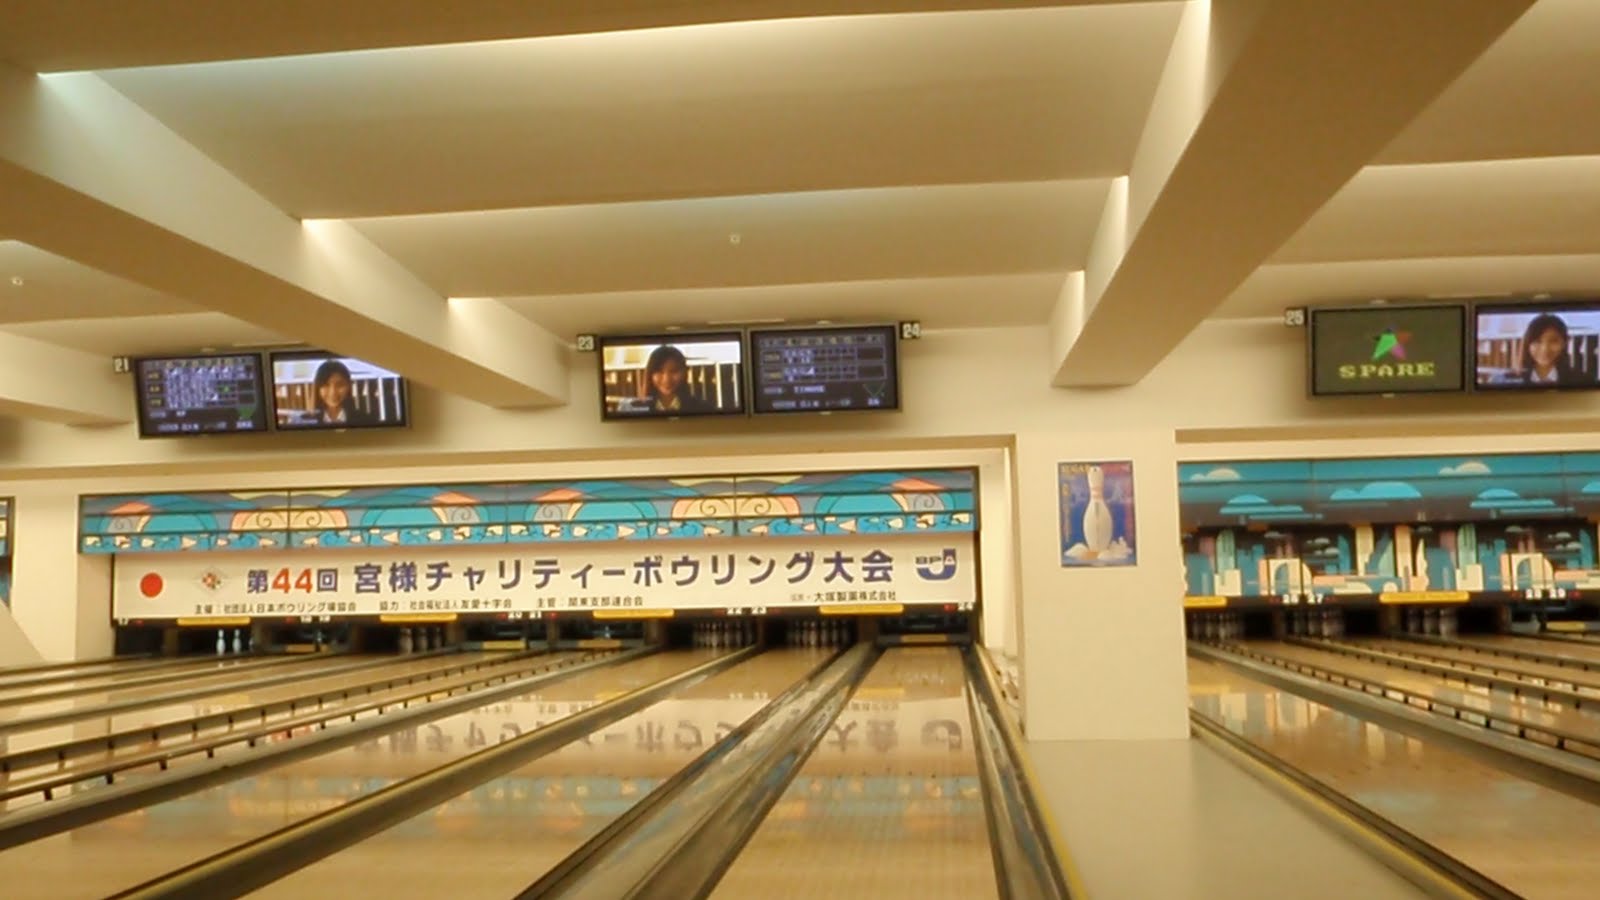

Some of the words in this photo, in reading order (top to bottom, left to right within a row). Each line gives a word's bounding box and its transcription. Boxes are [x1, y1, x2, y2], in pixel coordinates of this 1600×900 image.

[902, 323, 920, 338] 24
[577, 336, 594, 351] 23
[114, 357, 129, 372] 21
[1338, 361, 1435, 379] SPARE
[246, 567, 338, 594] 第44回
[353, 549, 894, 594] 宮様チャリティーボウリング大会
